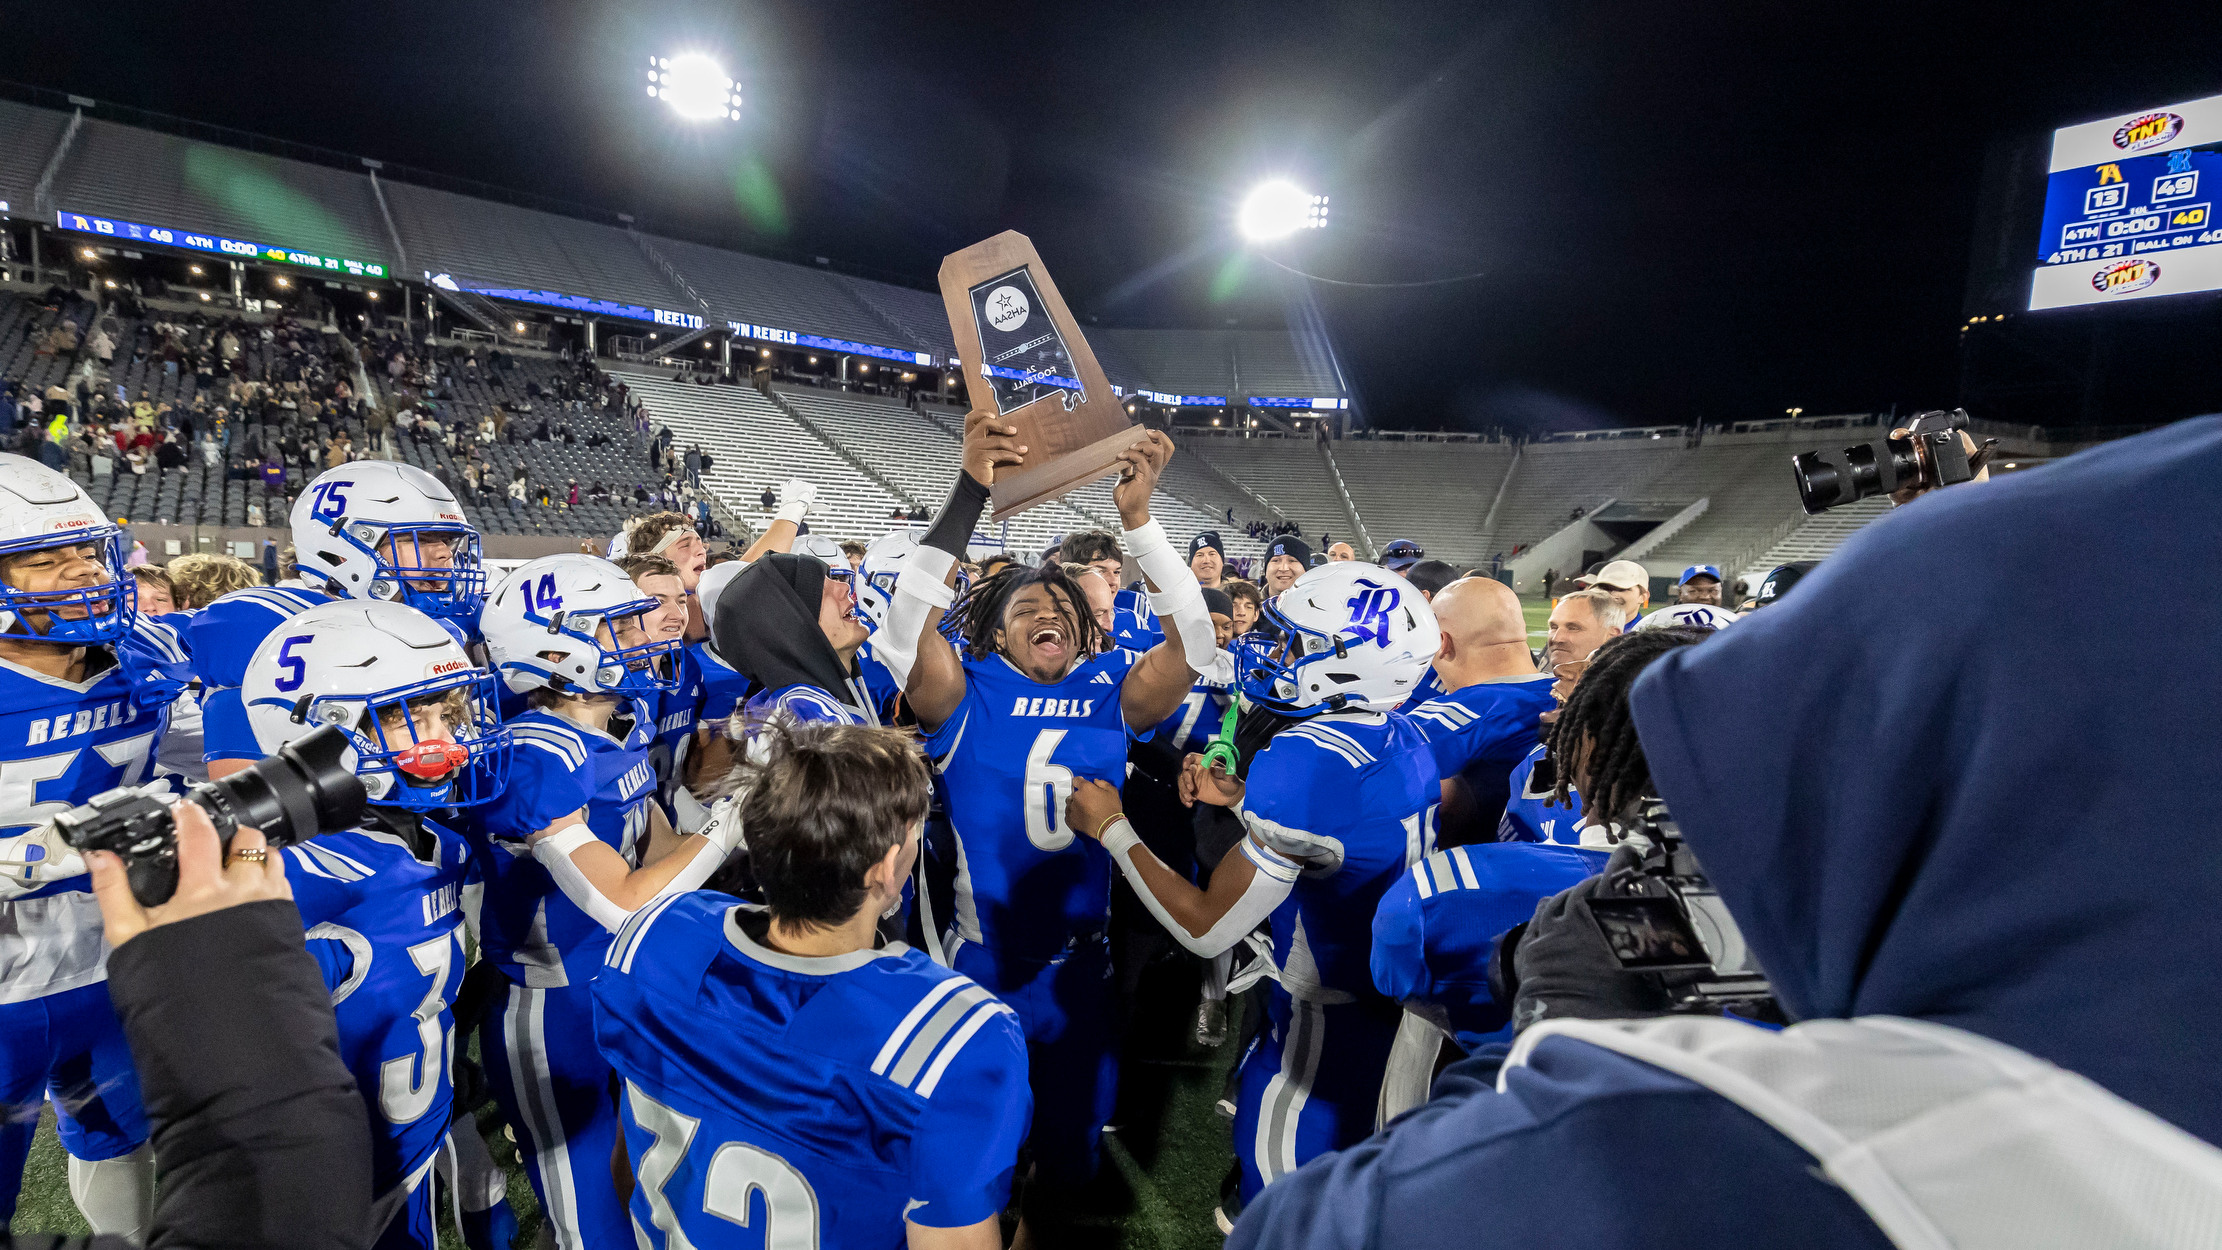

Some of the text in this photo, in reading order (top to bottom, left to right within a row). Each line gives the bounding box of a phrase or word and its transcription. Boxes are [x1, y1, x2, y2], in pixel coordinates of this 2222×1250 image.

[2128, 117, 2168, 144] TNT
[2092, 177, 2193, 207] 13 49
[2066, 209, 2204, 240] 4TH 0:00 40
[94, 220, 114, 234] 13
[149, 229, 173, 243] 49
[185, 235, 213, 249] 4TH
[220, 239, 258, 256] 0:00
[266, 249, 286, 261] 40
[324, 258, 339, 270] 21
[2047, 249, 2089, 263] 4TH
[2102, 243, 2123, 257] 21
[2136, 229, 2222, 251] BALL ON 40
[365, 264, 383, 276] 40
[2105, 263, 2145, 287] TNT
[752, 323, 798, 345] REBELS
[1154, 391, 1182, 405] REBELS
[311, 481, 355, 519] 75
[519, 573, 564, 613] 14
[275, 634, 315, 693] 5
[1010, 696, 1095, 718] REBELS
[26, 702, 138, 747] REBELS
[618, 758, 651, 801] REBELS
[1023, 728, 1077, 852] 6
